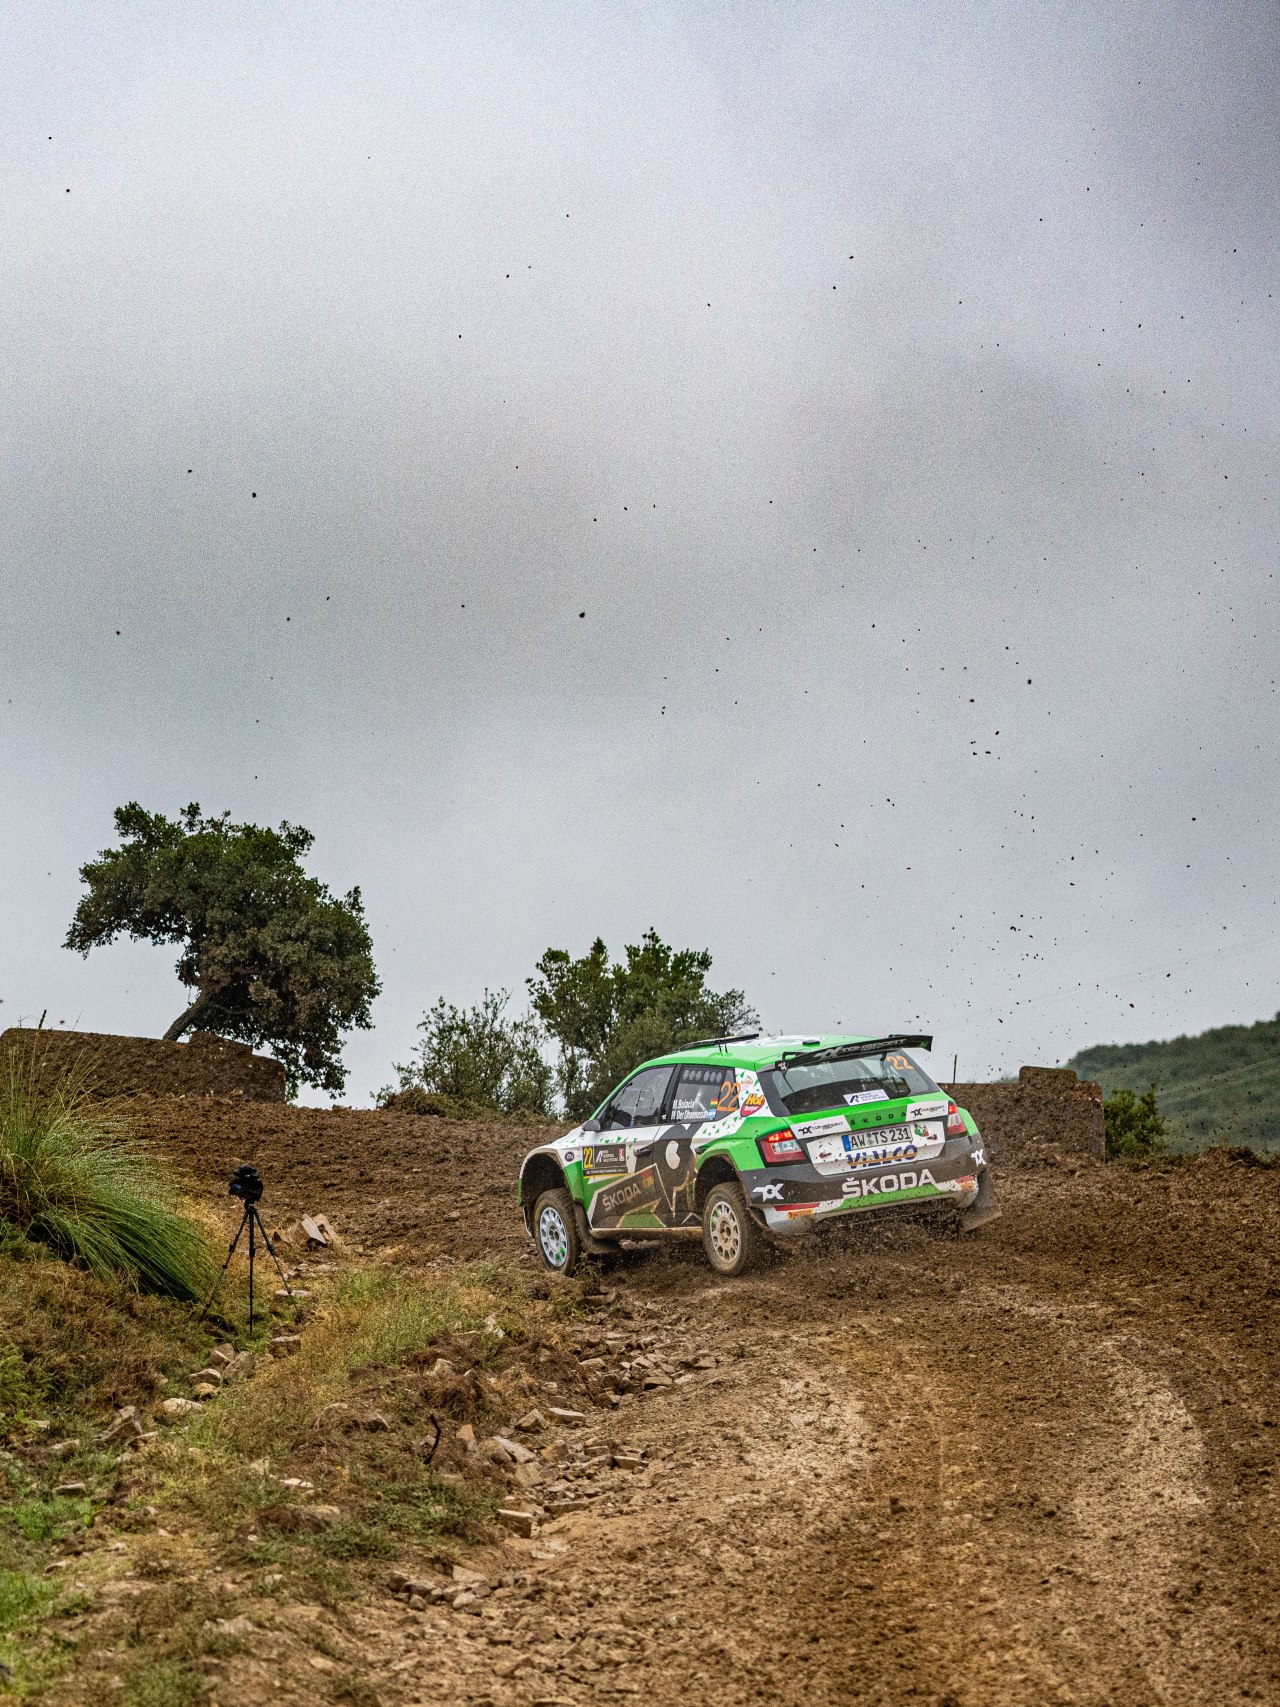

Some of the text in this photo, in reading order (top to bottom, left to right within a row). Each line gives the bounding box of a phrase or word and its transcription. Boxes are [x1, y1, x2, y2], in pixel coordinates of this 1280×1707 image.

[887, 1055, 914, 1070] 22
[717, 1081, 740, 1112] 22
[851, 1127, 911, 1149] AW TS 231
[583, 1147, 594, 1169] 22
[841, 1168, 937, 1199] ŠKODA
[601, 1182, 642, 1212] ŠKODA
